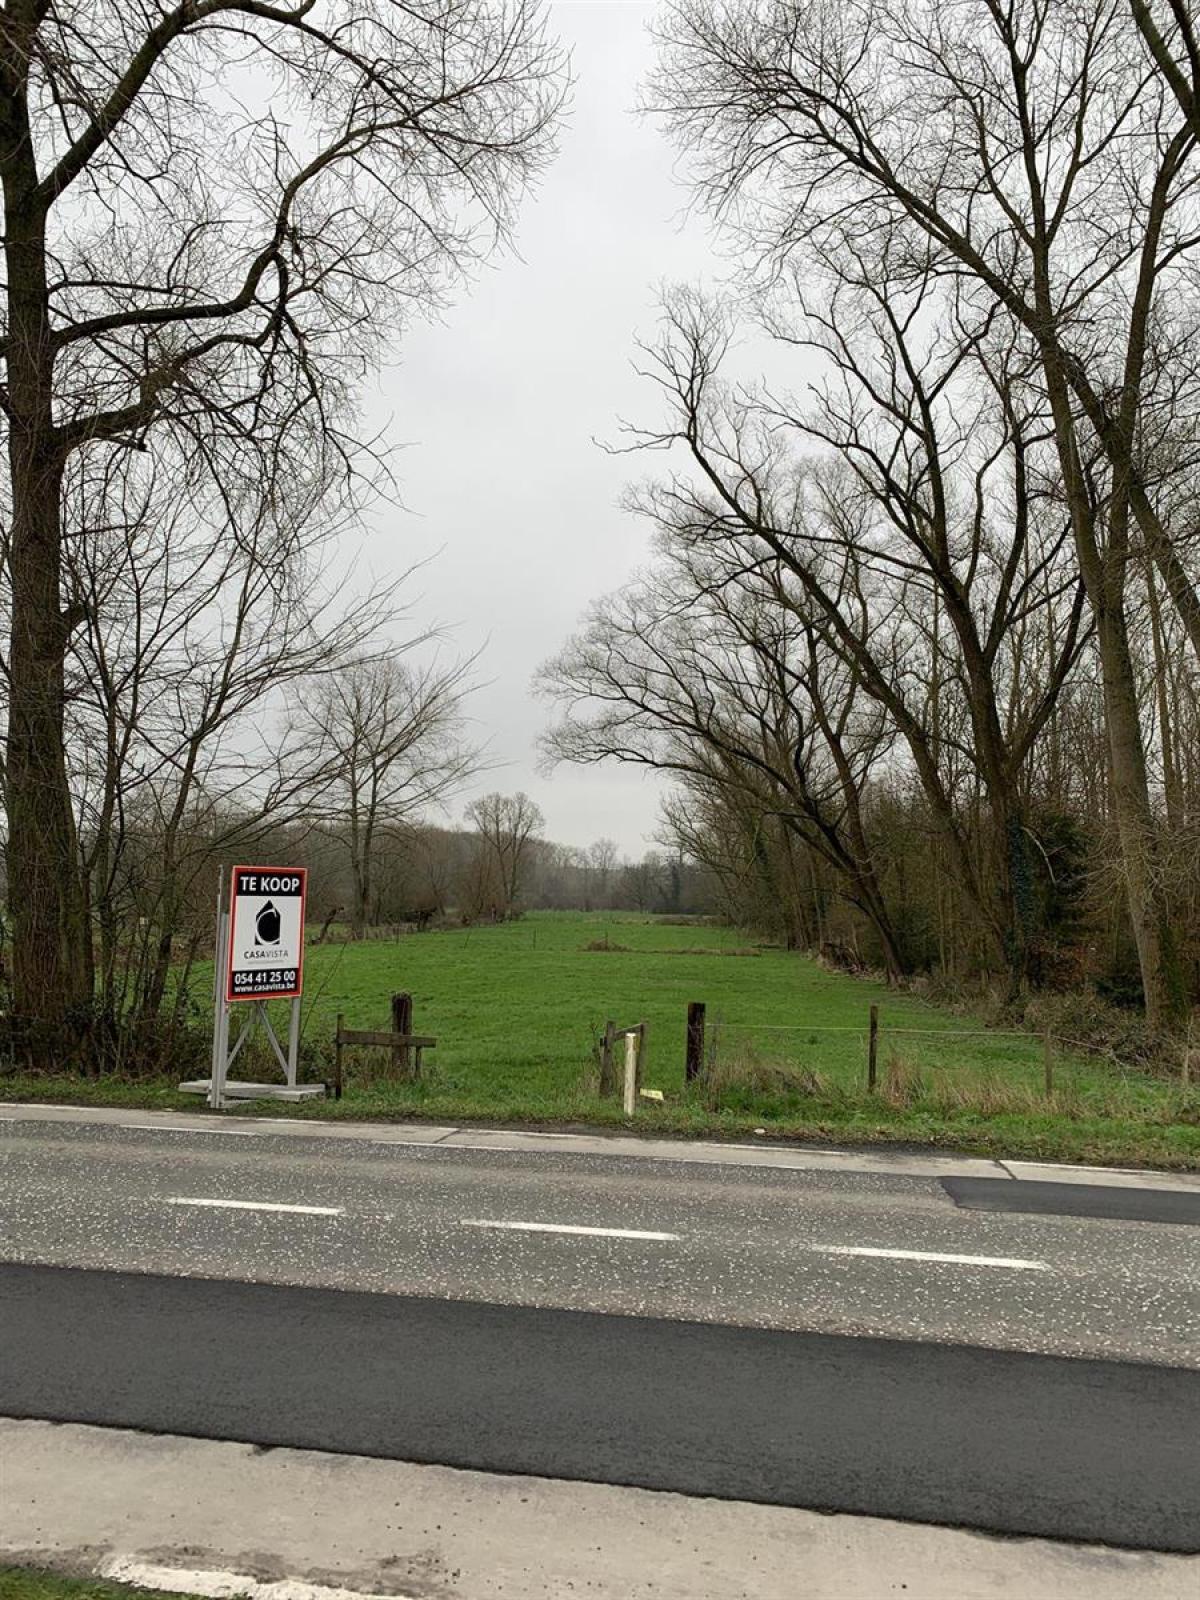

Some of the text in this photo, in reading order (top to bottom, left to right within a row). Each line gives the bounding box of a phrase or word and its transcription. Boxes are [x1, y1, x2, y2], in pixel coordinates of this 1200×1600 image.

[240, 876, 299, 892] TE KOOP
[244, 950, 289, 959] CASAVISTA
[235, 970, 296, 985] 054 41 25 00
[234, 983, 295, 993] www.casavista.be
